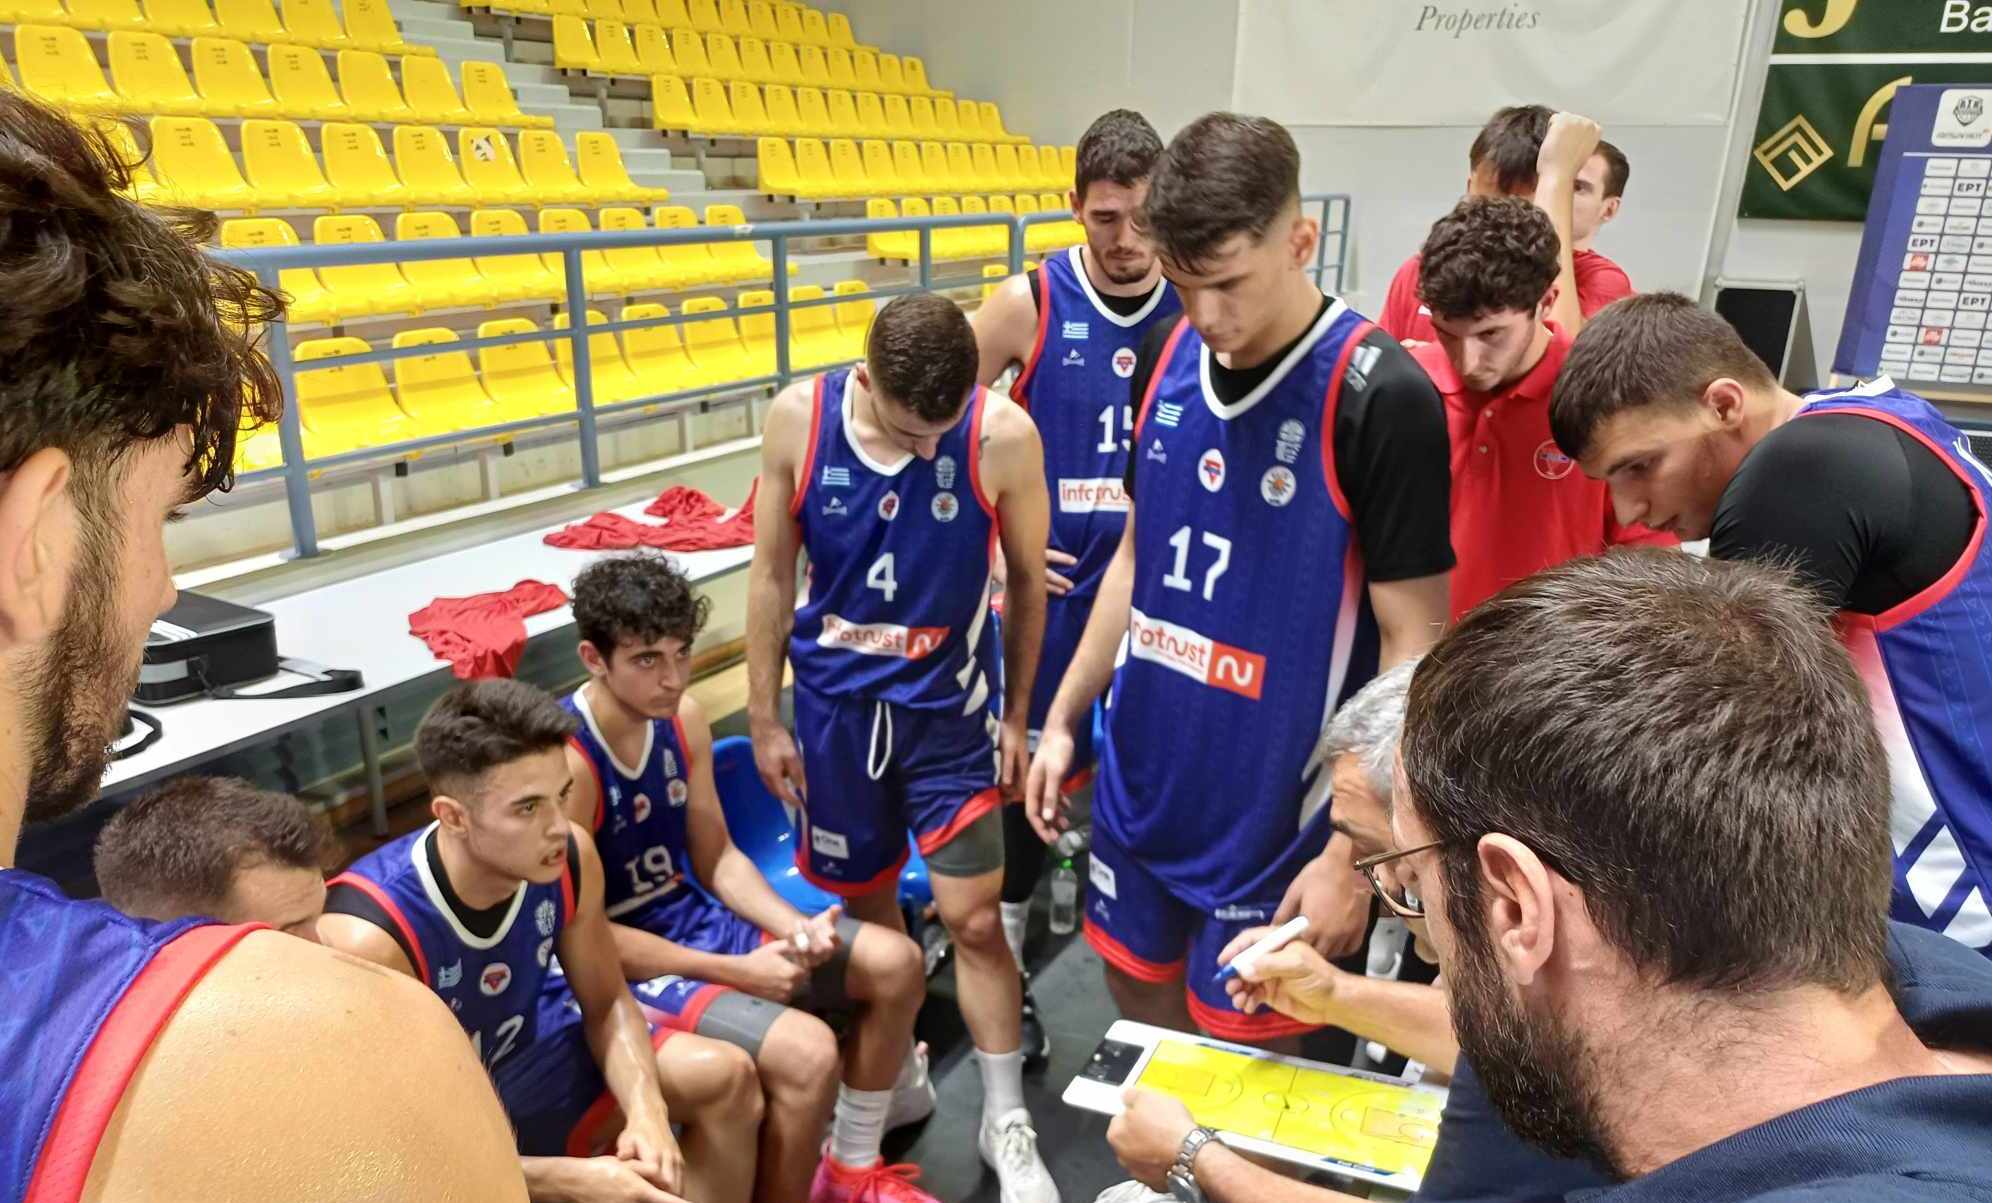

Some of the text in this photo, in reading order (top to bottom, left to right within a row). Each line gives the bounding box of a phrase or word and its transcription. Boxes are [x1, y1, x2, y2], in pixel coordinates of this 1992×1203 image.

[1415, 2, 1541, 39] Properties
[866, 552, 898, 602] 4
[1163, 525, 1232, 601] 17
[624, 845, 675, 894] 19
[472, 1014, 525, 1064] 2
